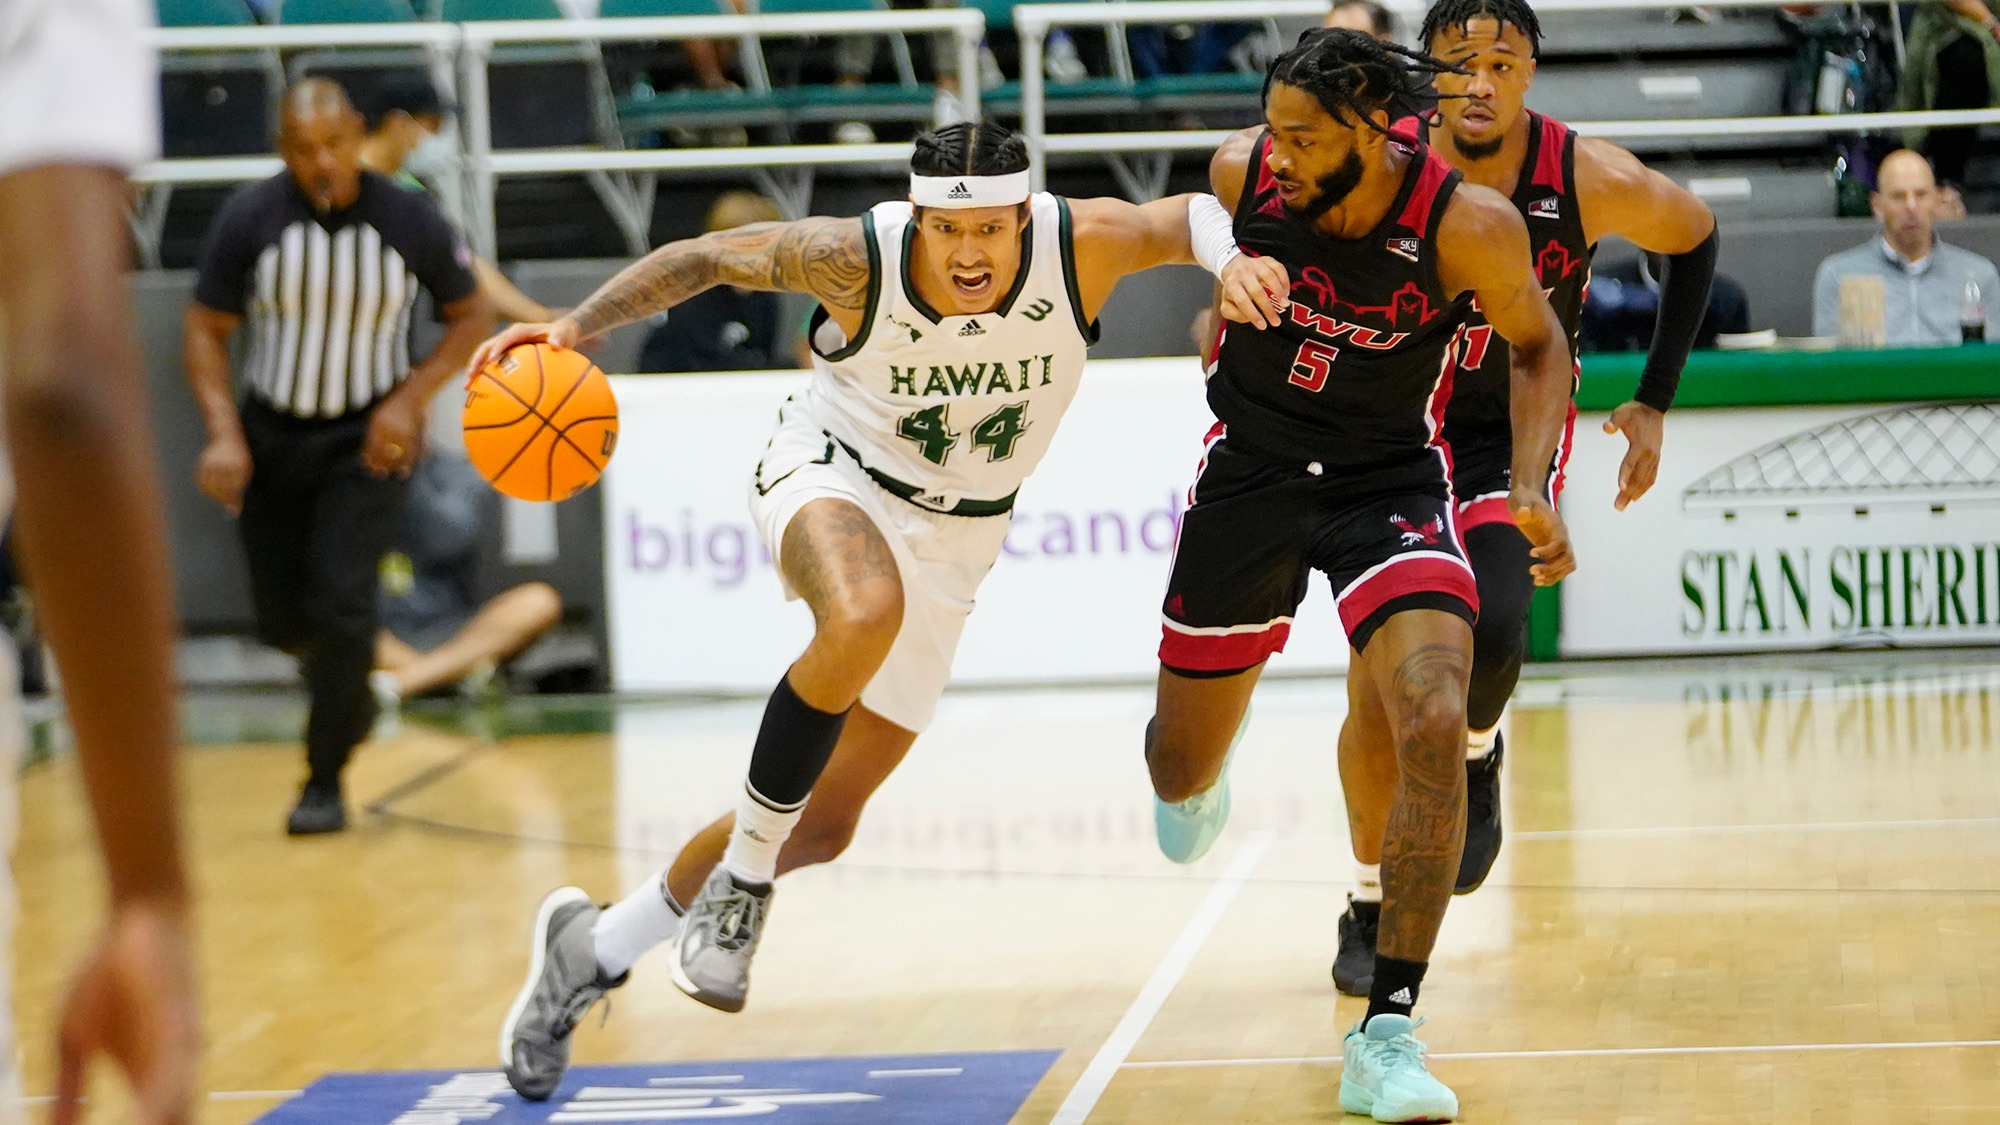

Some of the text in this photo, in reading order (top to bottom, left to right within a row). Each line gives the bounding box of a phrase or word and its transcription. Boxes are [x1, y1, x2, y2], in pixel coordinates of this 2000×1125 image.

[947, 192, 973, 200] adidas
[1400, 240, 1417, 251] SKY
[957, 328, 987, 337] adidas
[889, 354, 1054, 396] HAWAI'I
[1288, 339, 1340, 393] 5
[896, 400, 1034, 467] 44
[1679, 542, 2000, 635] STAN SHERI
